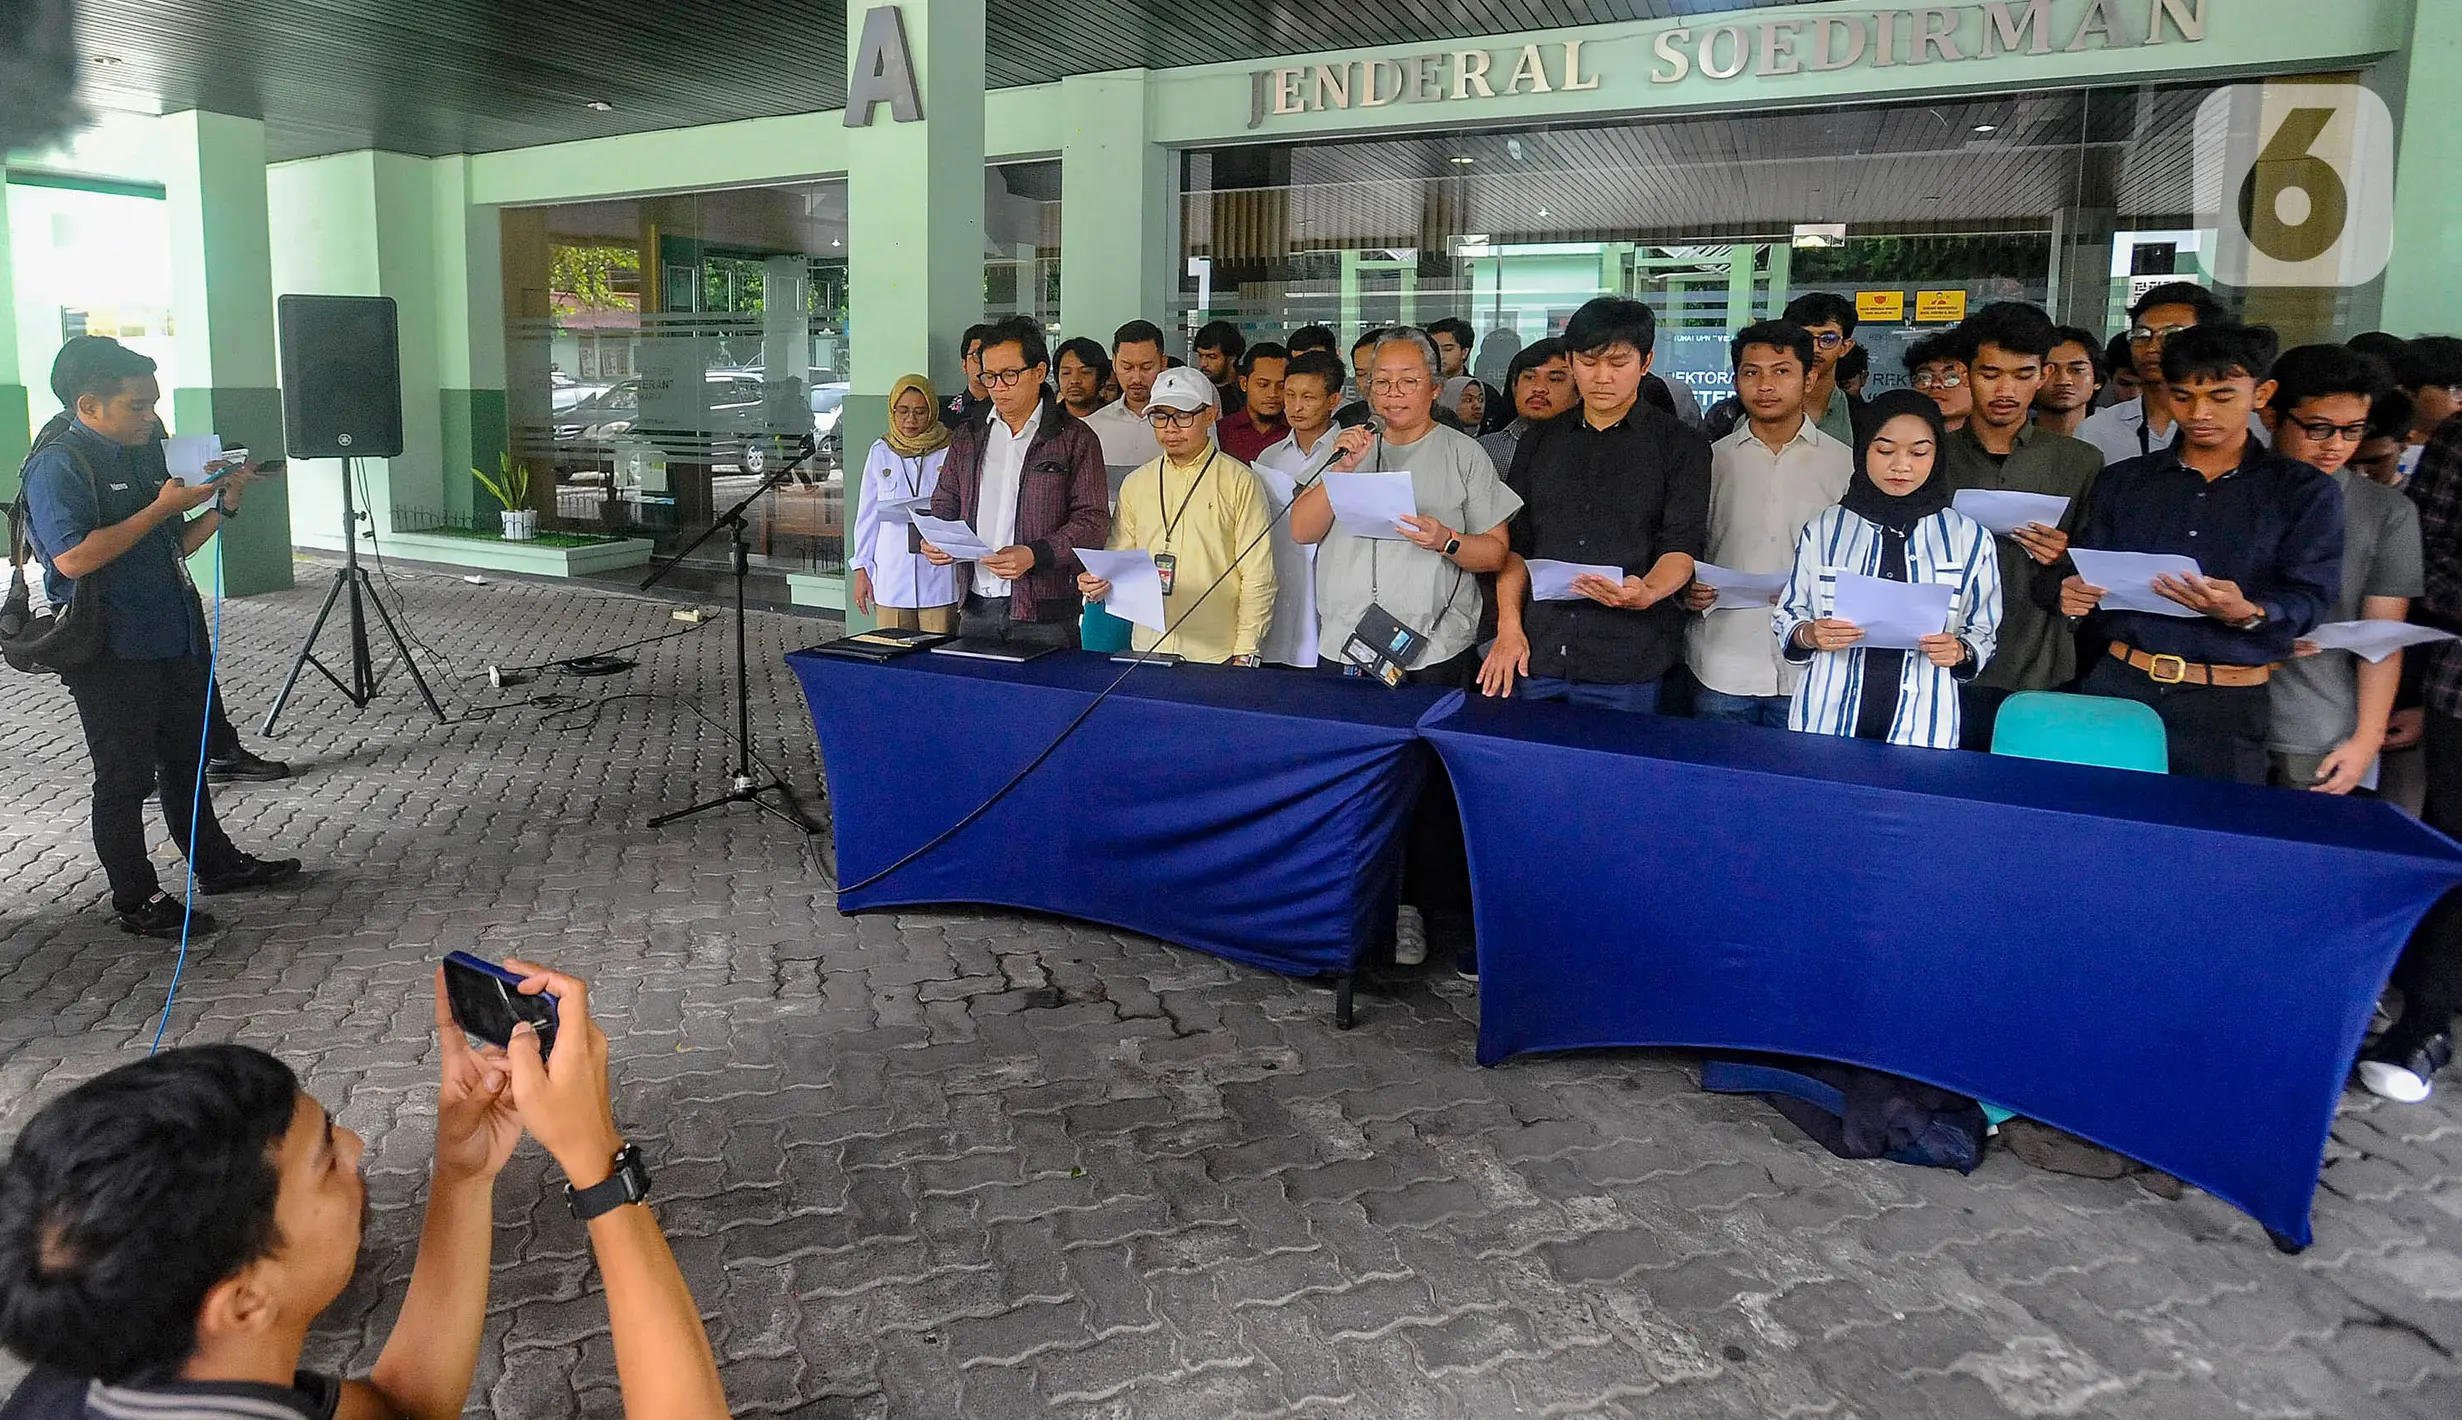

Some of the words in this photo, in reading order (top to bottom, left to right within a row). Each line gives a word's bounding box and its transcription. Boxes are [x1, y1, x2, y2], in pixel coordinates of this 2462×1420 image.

[843, 6, 924, 128] A
[1247, 39, 1601, 130] JENDERAL
[1651, 0, 2204, 85] SOEDIRMAN
